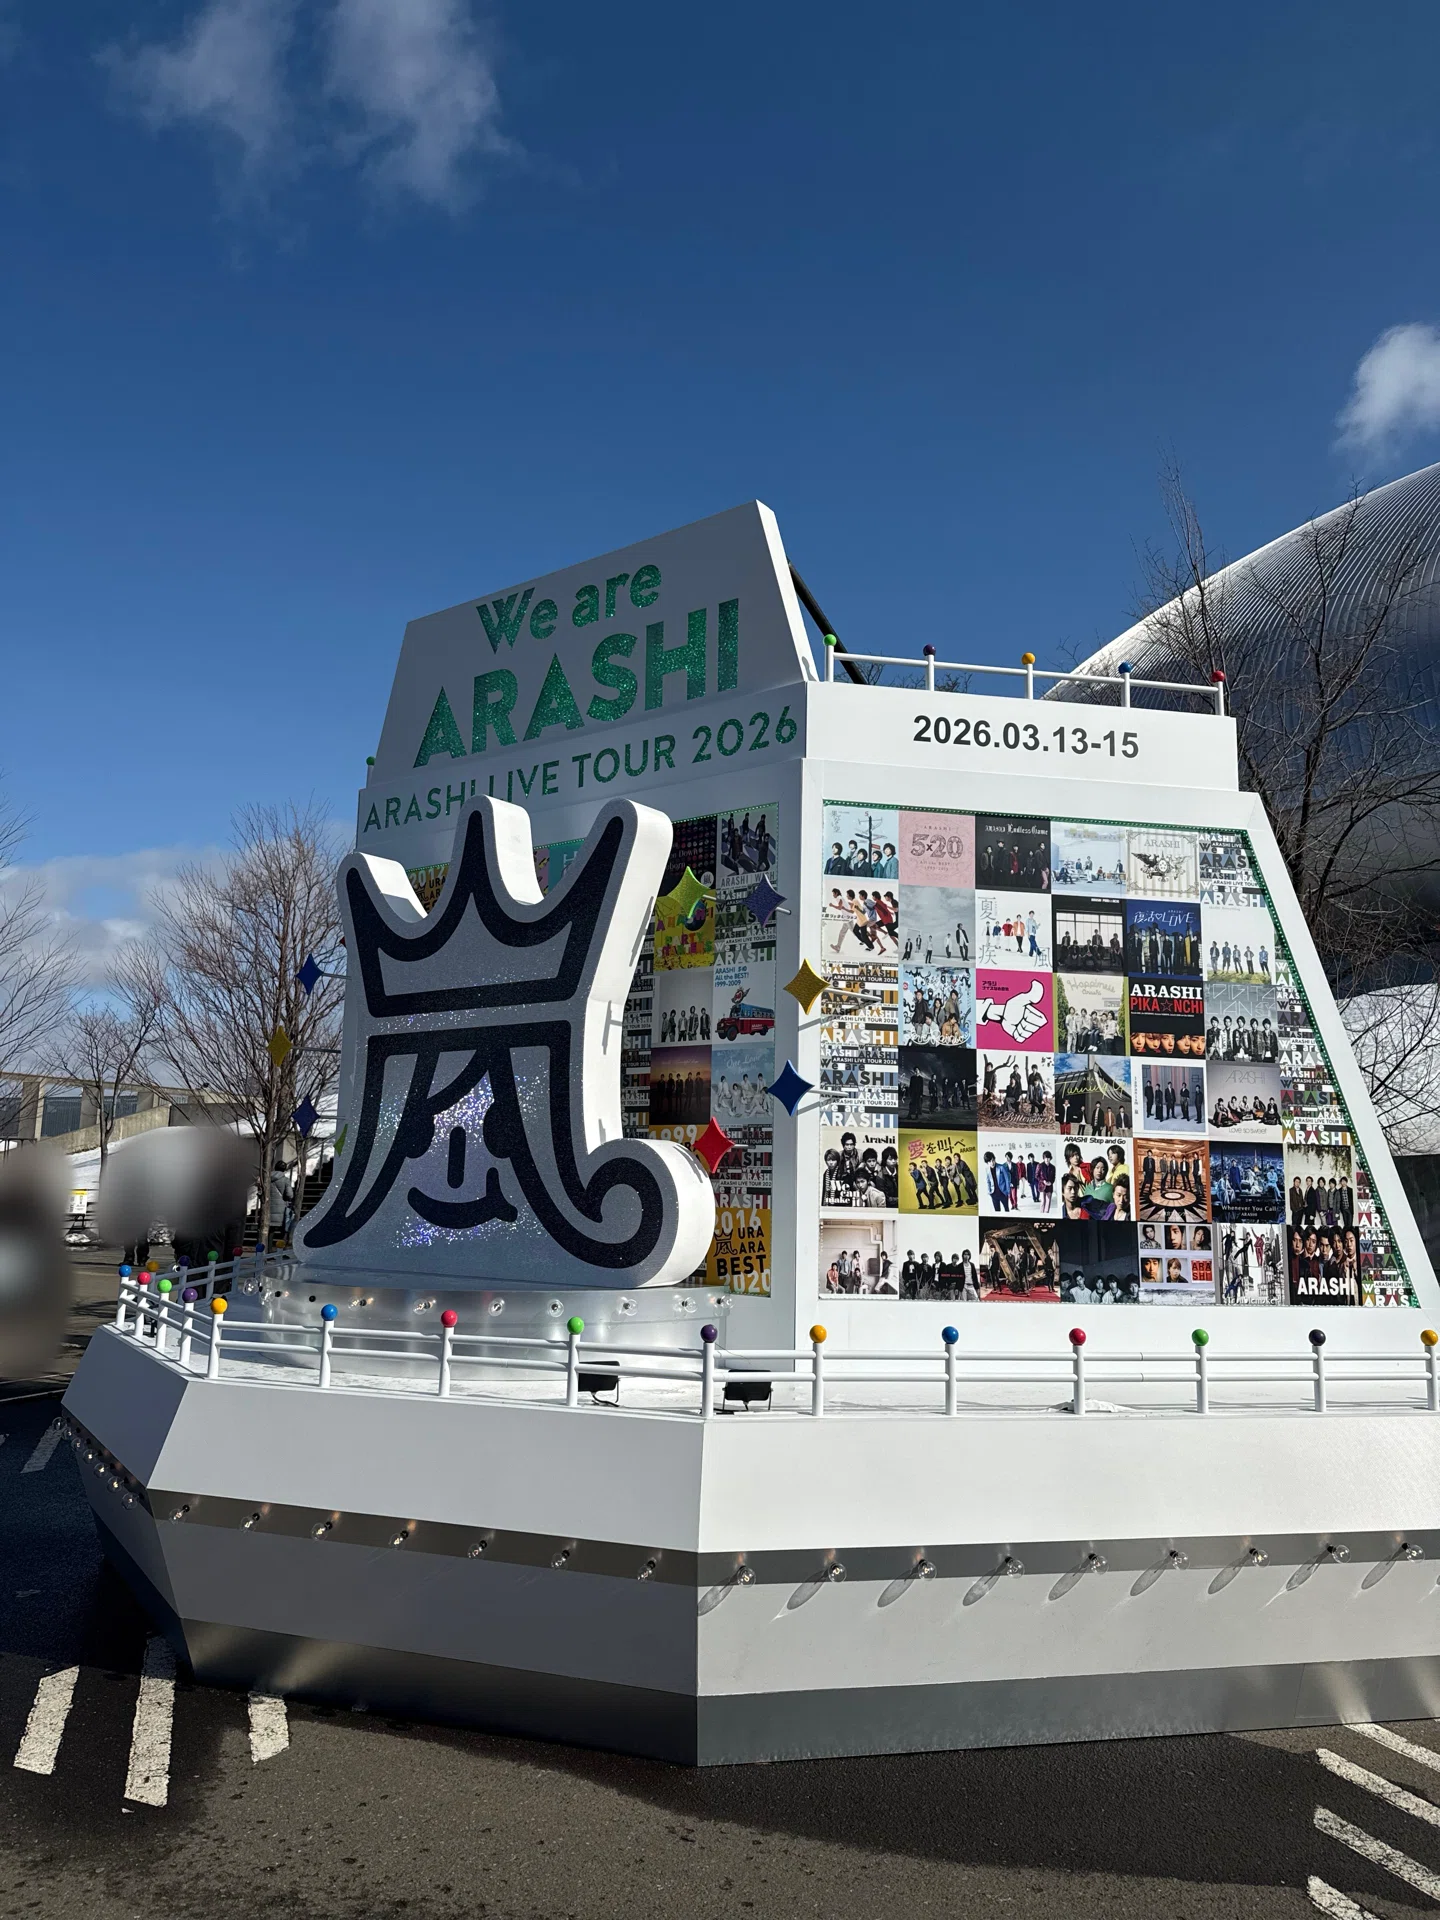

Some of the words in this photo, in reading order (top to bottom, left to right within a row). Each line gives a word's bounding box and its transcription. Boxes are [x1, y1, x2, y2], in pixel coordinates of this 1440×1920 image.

[476, 587, 557, 653] We
[572, 564, 662, 627] are
[413, 598, 739, 768] ARASHI
[913, 715, 1139, 758] 2026.03.13-15
[489, 760, 559, 803] LIVE
[572, 734, 676, 789] TOUR
[692, 705, 798, 764] 2026
[1144, 839, 1181, 849] ARASHI
[1199, 853, 1247, 868] ARAS
[720, 875, 748, 887] ARASHI
[1200, 892, 1260, 908] ARASH
[978, 896, 997, 921] 夏
[1130, 983, 1203, 1000] ARASHI
[1130, 997, 1160, 1012] PIKA
[1173, 999, 1203, 1014] NCHI
[821, 1029, 894, 1045] ARASHI
[1280, 1051, 1325, 1066] ARAS
[820, 1070, 894, 1086] ARASHI
[1281, 1090, 1339, 1106] ARASH
[820, 1112, 894, 1128] ARASHI
[862, 1135, 896, 1144] Arashi
[1283, 1131, 1352, 1146] ARASHI
[908, 1137, 966, 1160] 愛を叫べ
[830, 1180, 850, 1191] We
[738, 1226, 764, 1239] URA
[739, 1241, 766, 1254] ARA
[717, 1254, 767, 1277] BEST
[719, 1268, 771, 1293] 2020
[1297, 1277, 1356, 1296] ARASHI
[1364, 1295, 1410, 1307] ARAS
